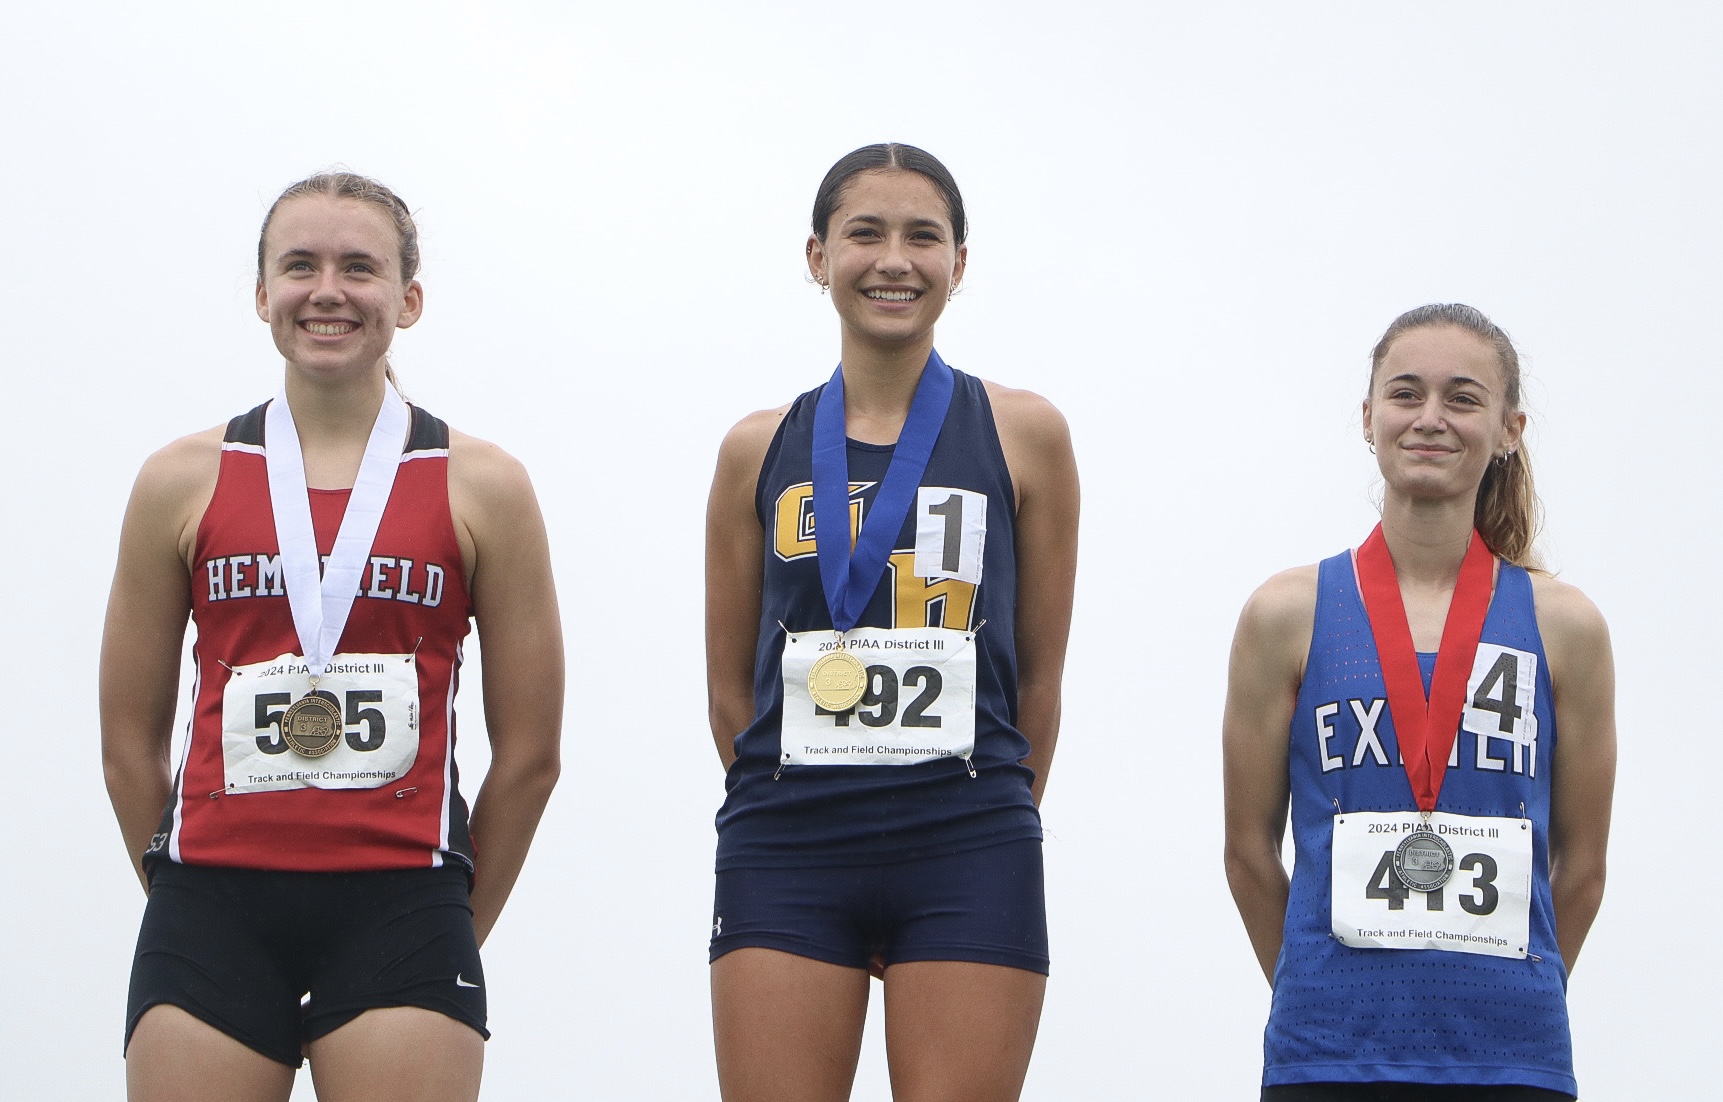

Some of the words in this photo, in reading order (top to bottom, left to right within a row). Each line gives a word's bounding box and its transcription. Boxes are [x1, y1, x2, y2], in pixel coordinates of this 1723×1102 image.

[928, 493, 963, 573] 1
[206, 554, 445, 608] HEMELD
[849, 638, 880, 650] PIAA
[884, 639, 930, 650] District
[933, 639, 944, 650] III
[288, 664, 311, 675] PIA
[324, 662, 370, 674] District
[373, 663, 385, 674] III
[1472, 652, 1522, 734] 4
[255, 690, 386, 755] 55
[297, 715, 328, 723] DISTRICT
[300, 723, 307, 731] 3
[804, 745, 829, 755] Track
[831, 746, 849, 755] and
[851, 745, 874, 755] Field
[876, 746, 952, 757] Championships
[248, 774, 274, 784] Track
[275, 772, 294, 782] and
[296, 771, 320, 781] Field
[322, 770, 396, 781] Championships
[1367, 823, 1398, 834] 2024
[1402, 822, 1434, 834] PIAA
[1438, 824, 1485, 838] District
[1488, 828, 1499, 839] III
[1408, 849, 1441, 857] DISTRICT
[1357, 928, 1385, 938] Track
[1387, 929, 1406, 939] and
[1408, 929, 1433, 939] Field
[1435, 930, 1508, 947] Championships
